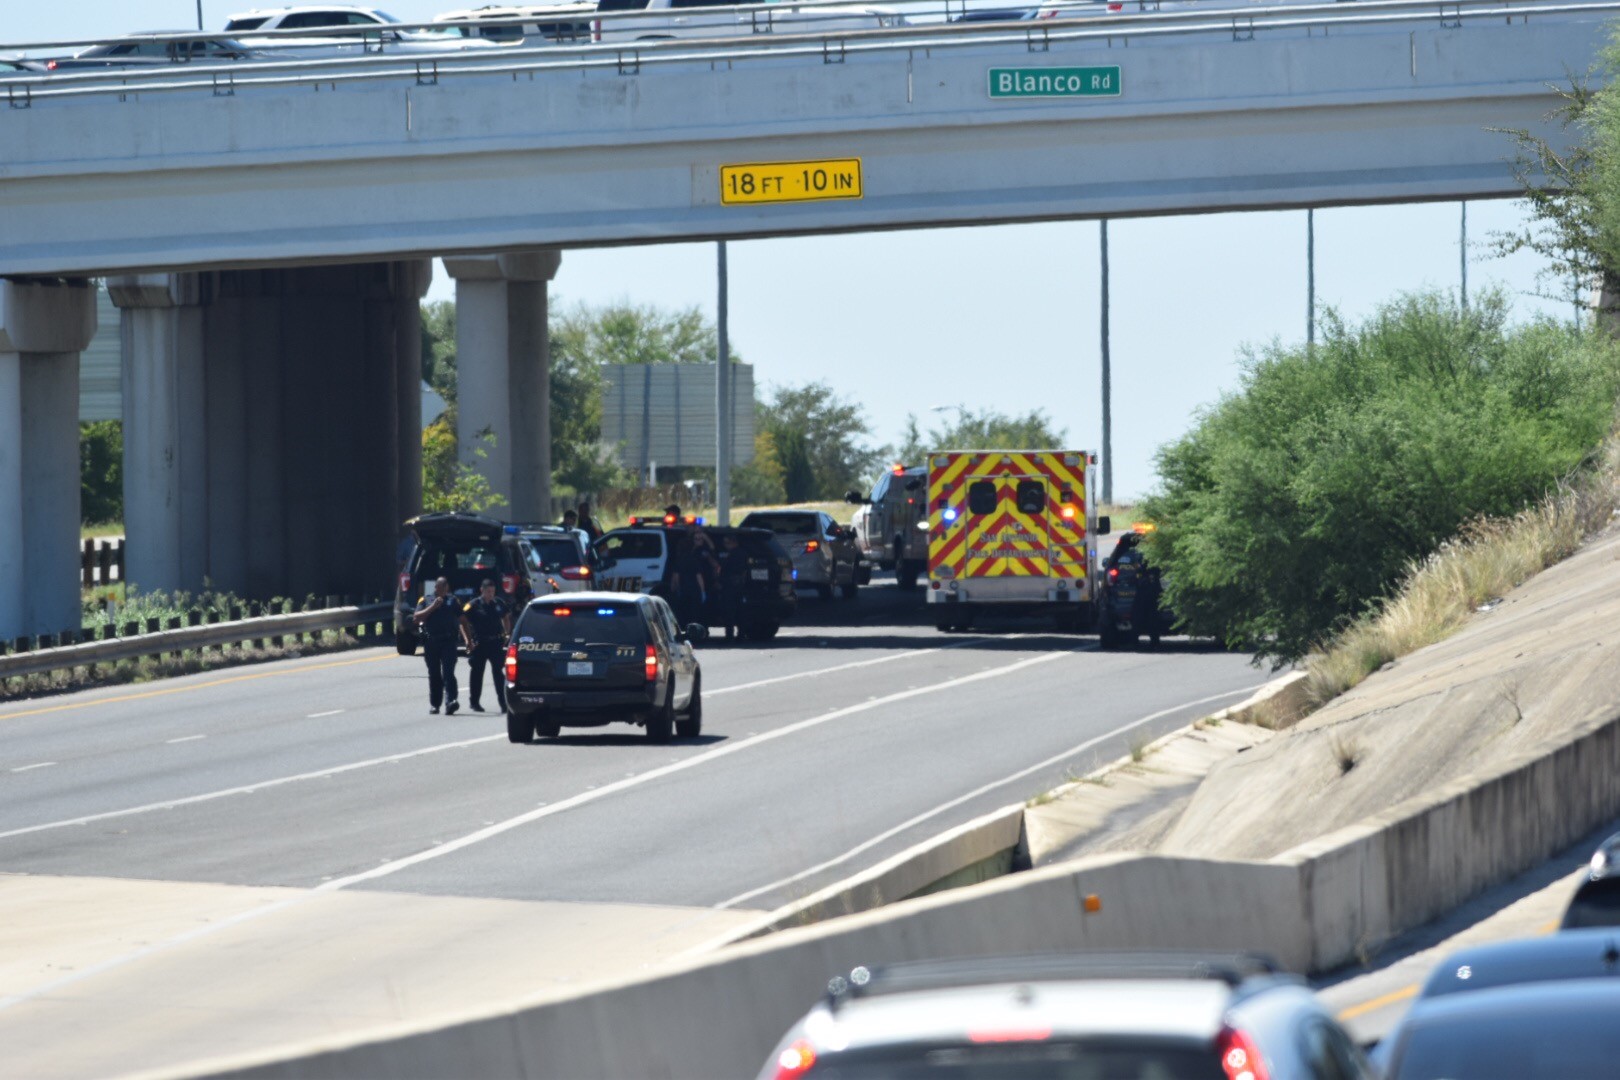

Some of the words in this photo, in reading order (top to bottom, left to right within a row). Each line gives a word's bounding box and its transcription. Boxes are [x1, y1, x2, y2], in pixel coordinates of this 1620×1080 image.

[999, 71, 1081, 92] Blanco
[1091, 73, 1111, 90] Rd
[730, 172, 756, 195] 18
[761, 176, 784, 194] FT
[802, 169, 828, 192] 10
[833, 172, 853, 190] IN
[518, 643, 561, 652] POLICE
